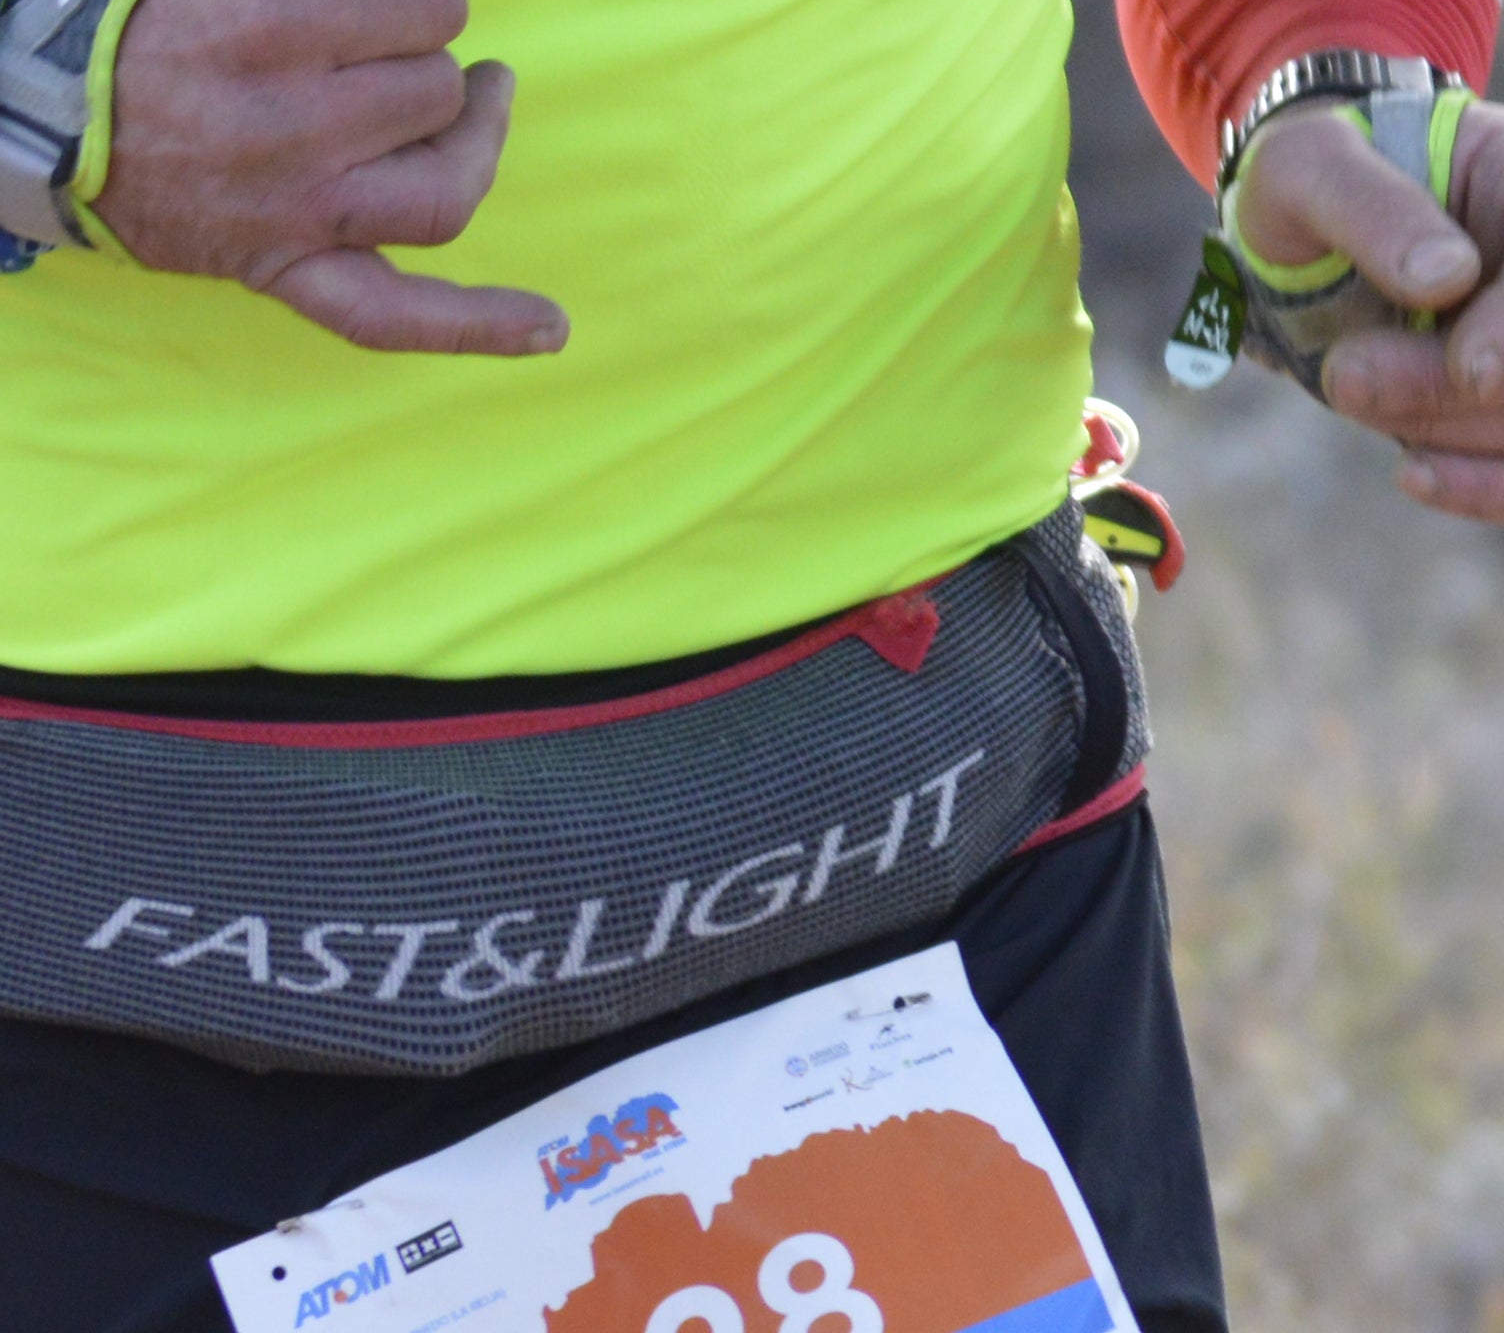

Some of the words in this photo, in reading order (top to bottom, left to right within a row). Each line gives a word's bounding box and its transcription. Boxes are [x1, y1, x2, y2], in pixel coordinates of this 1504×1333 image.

[82, 747, 985, 1003] FAST&LIGHT
[539, 1106, 683, 1195] ISASA
[293, 1261, 392, 1330] ATOM
